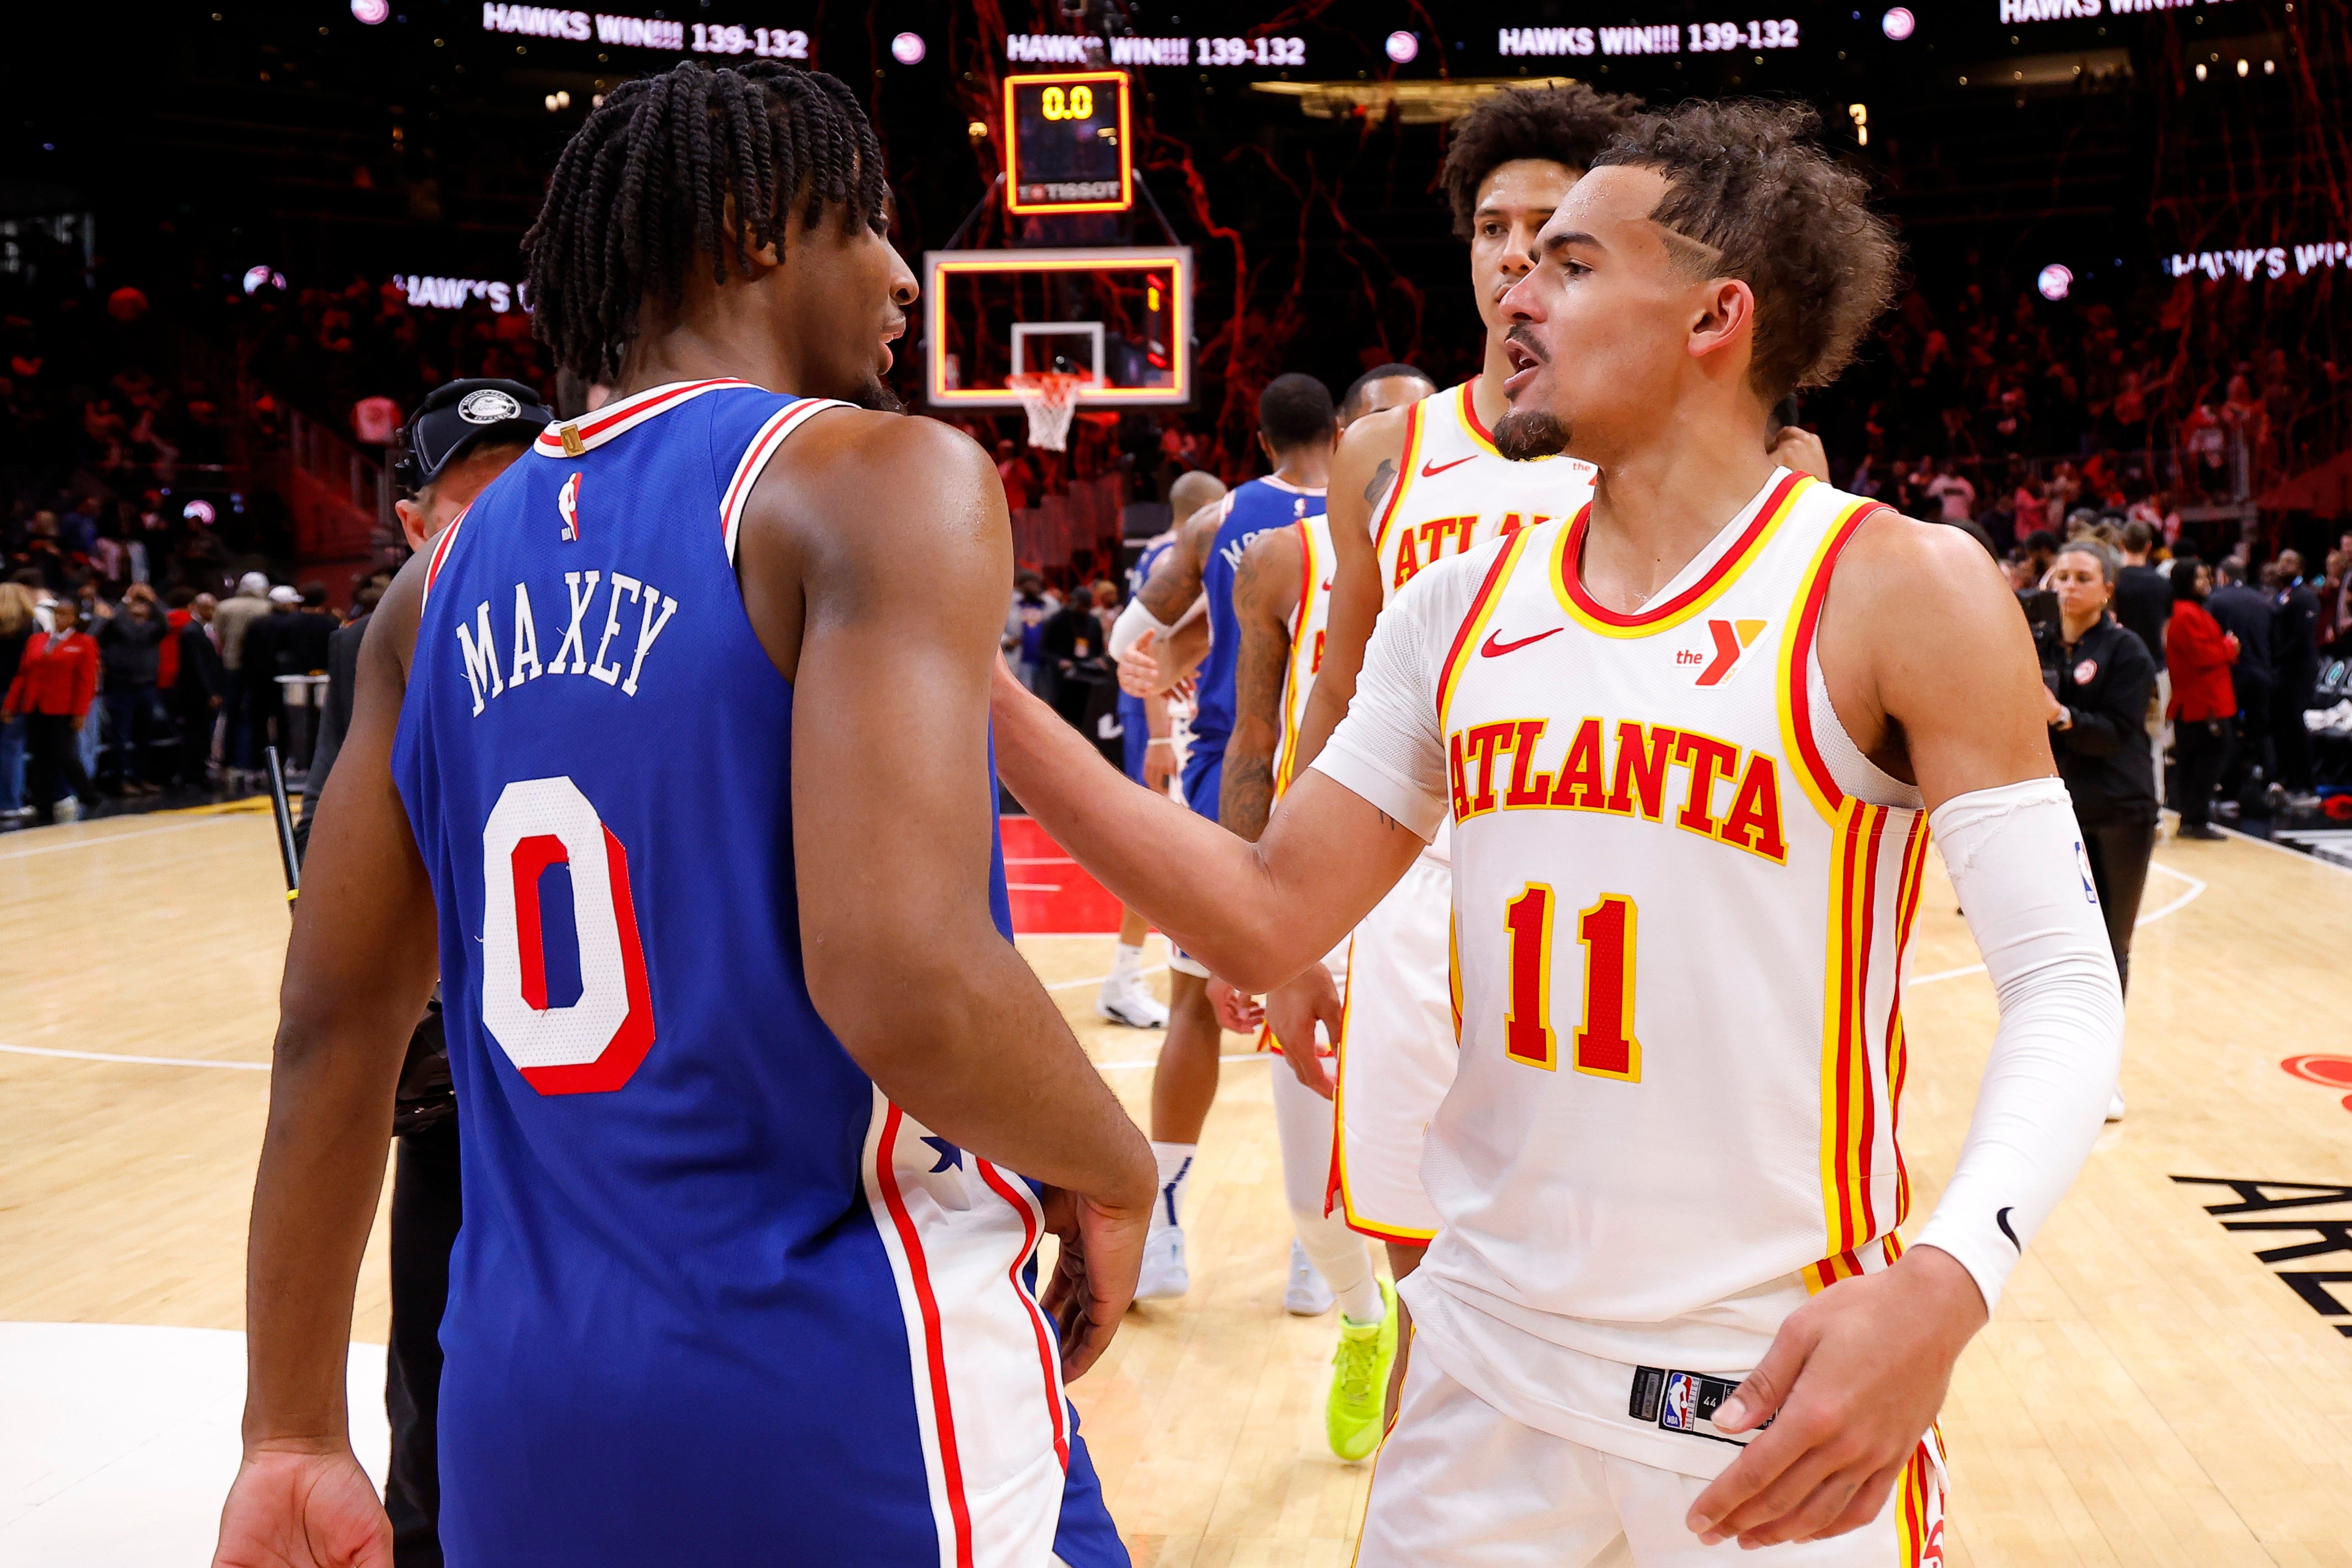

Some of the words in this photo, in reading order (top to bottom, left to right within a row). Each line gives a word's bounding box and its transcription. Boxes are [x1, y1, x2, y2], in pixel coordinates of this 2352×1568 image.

[483, 2, 591, 41] HAWKS
[595, 14, 684, 50] WIN!!!
[691, 23, 809, 59] 139-132
[1499, 27, 1595, 56] HAWKS
[1599, 25, 1680, 55] WIN!!!
[1687, 19, 1799, 52] 139-132
[1109, 36, 1189, 66] WIN!!!
[1196, 37, 1306, 66] 139-132
[1042, 85, 1093, 121] 0.0
[1573, 462, 1590, 472] the
[456, 570, 678, 718] MAXEY
[1676, 649, 1703, 664] the
[1720, 667, 1738, 685] YMCA
[1450, 716, 1789, 866] ATLANTA
[482, 775, 656, 1096] 0
[1503, 881, 1642, 1084] 11
[1703, 1395, 1717, 1408] 44
[1667, 1415, 1678, 1425] NBA
